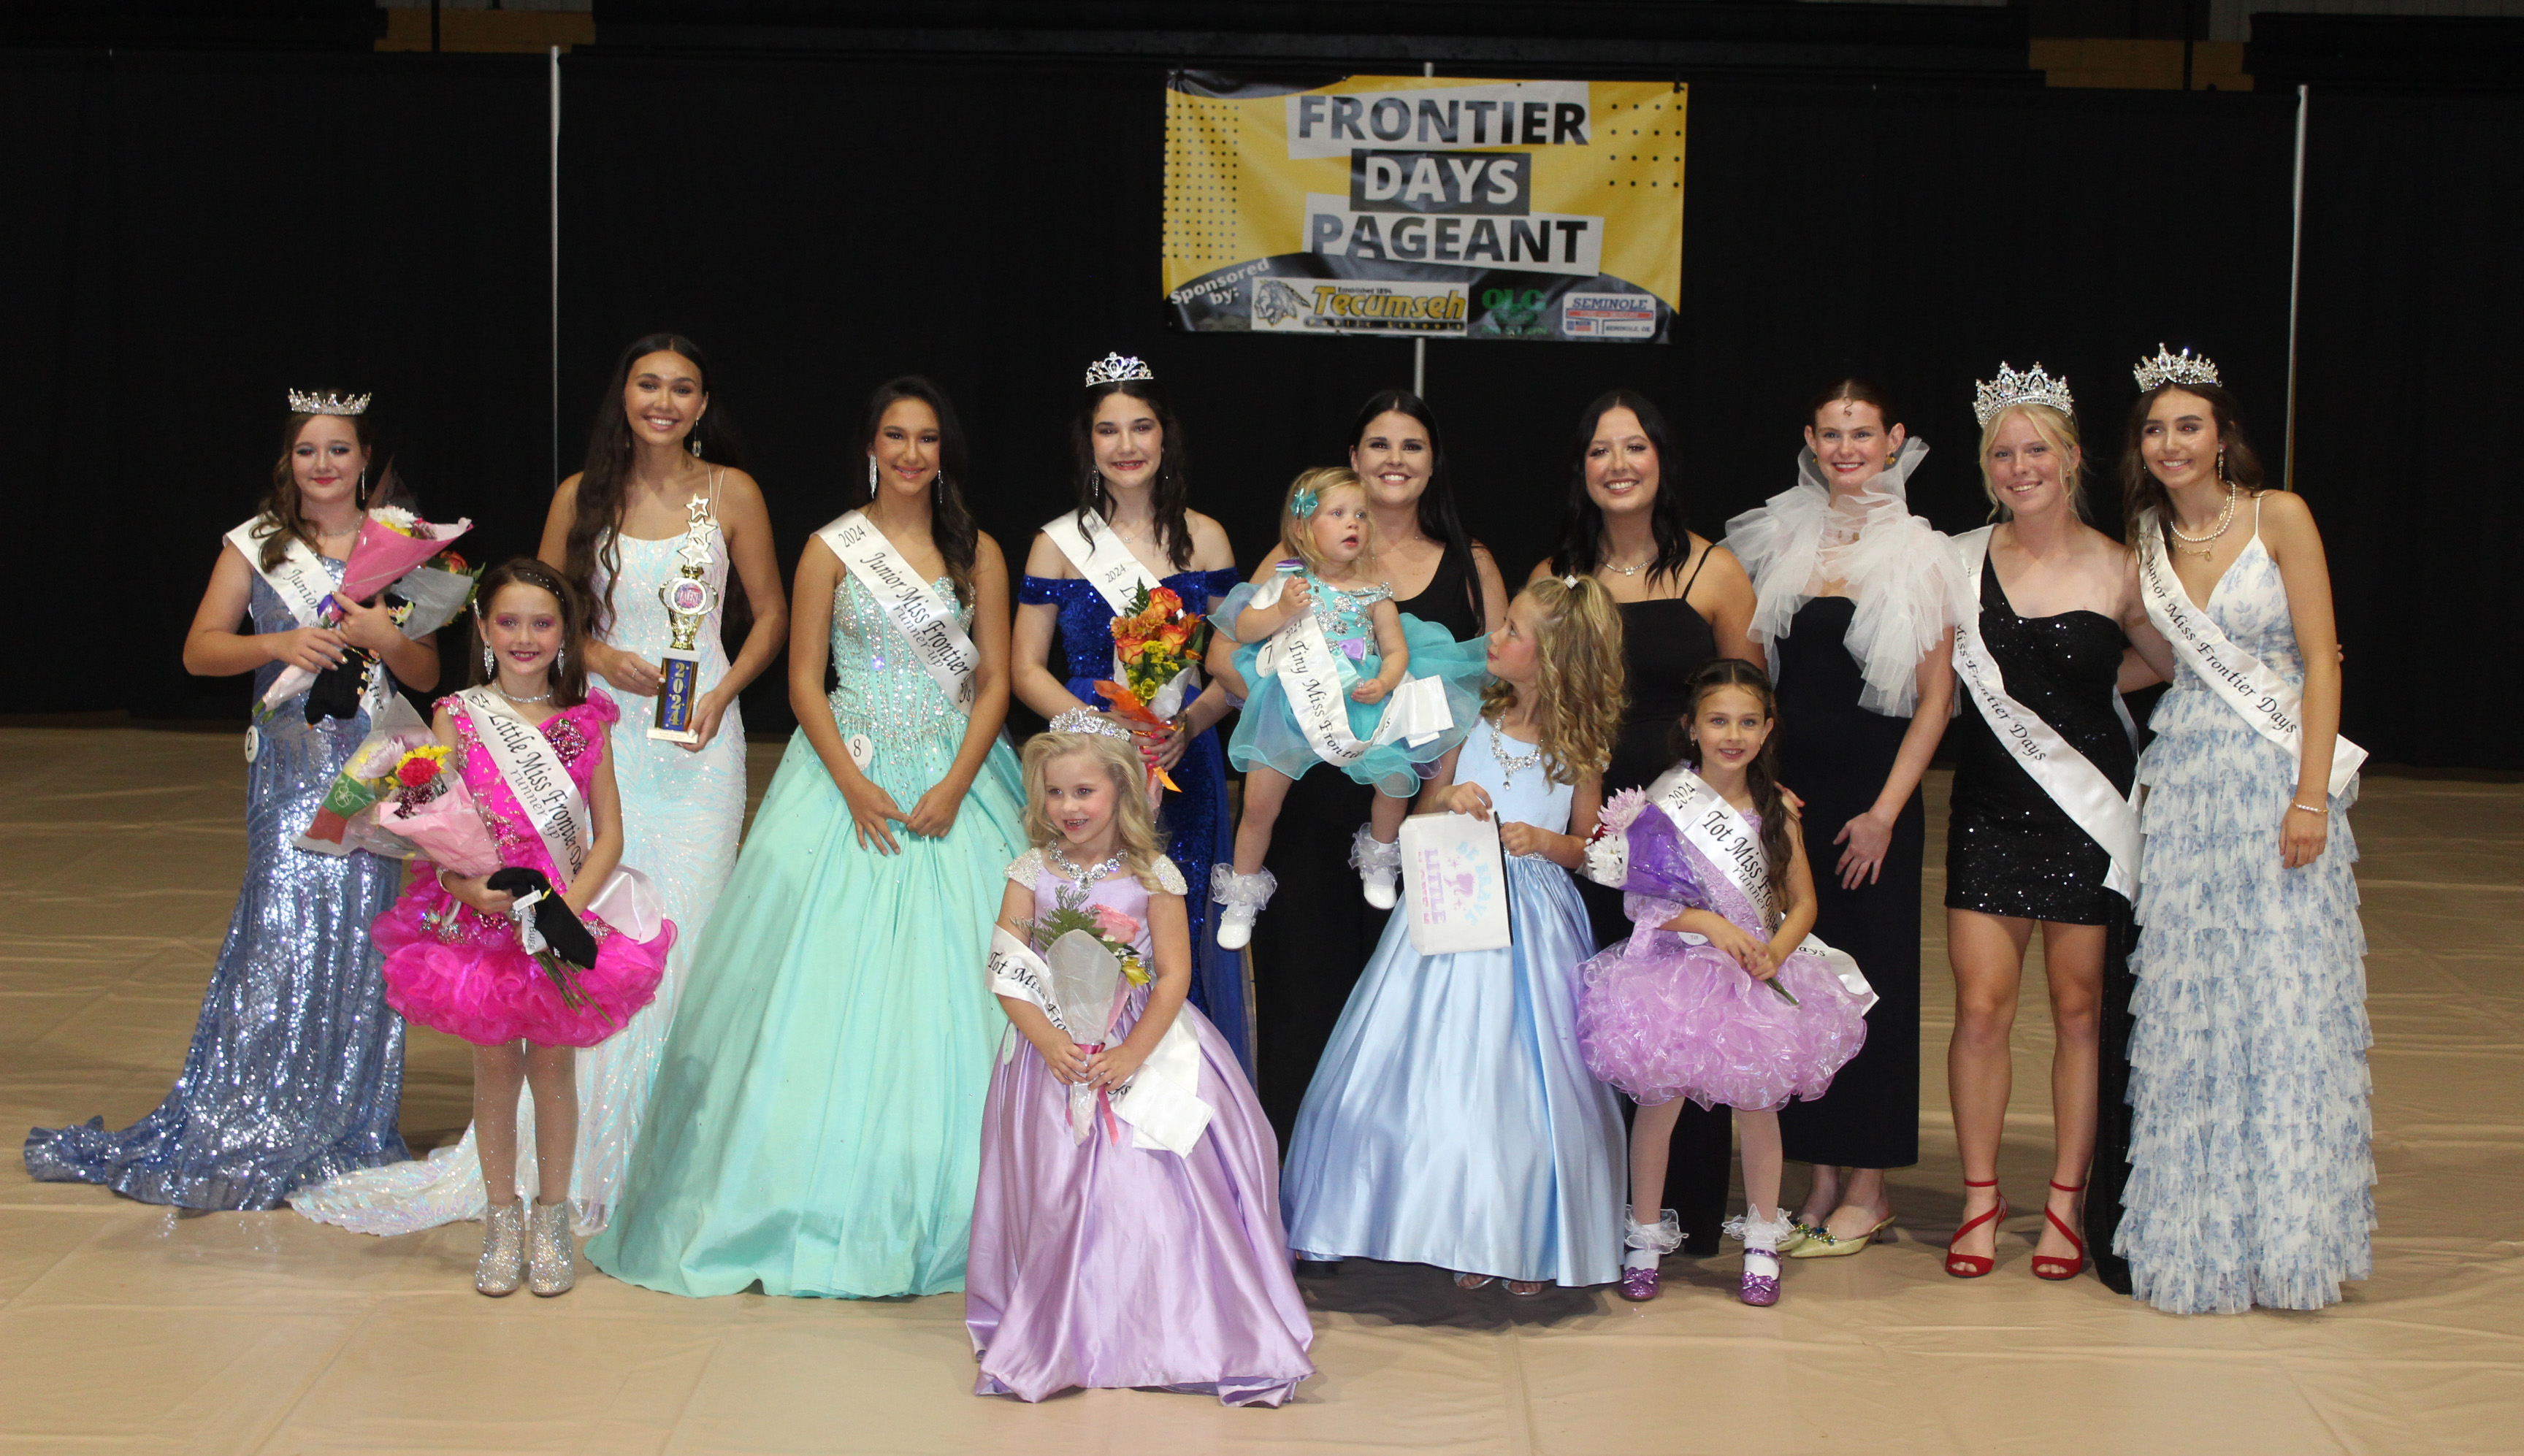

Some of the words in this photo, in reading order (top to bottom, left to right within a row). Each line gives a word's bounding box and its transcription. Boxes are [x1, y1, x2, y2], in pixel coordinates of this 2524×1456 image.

[1299, 96, 1589, 145] FRONTIER
[1364, 156, 1519, 204] DAYS
[1312, 215, 1588, 264] PAGEANT
[1170, 258, 1271, 304] Sponsored
[1209, 286, 1240, 306] by:
[1312, 286, 1466, 319] Tecumseh
[1572, 298, 1648, 310] SEMINOLE
[838, 524, 866, 548] 2024
[283, 569, 319, 609] Junior
[1104, 564, 1127, 583] 2024
[678, 590, 700, 603] TALENT
[860, 552, 907, 590] Junior
[895, 587, 930, 624] Miss
[922, 620, 970, 676] Frontier
[892, 605, 944, 667] runner-up
[1264, 644, 1273, 664] 7
[2146, 555, 2167, 599] Junior
[2164, 602, 2197, 642] Miss
[2197, 640, 2257, 698] Frontier
[2256, 697, 2298, 735] Days
[670, 662, 685, 726] 2024
[1289, 640, 1309, 673] Tiny
[1302, 678, 1327, 717] Miss
[854, 738, 861, 757] 8
[2009, 724, 2046, 761] Days
[489, 716, 535, 754] Little
[516, 751, 552, 792] Miss
[542, 789, 580, 850] Frontier
[570, 846, 582, 883] Da
[510, 768, 561, 839] runner-up
[1668, 781, 1699, 810] 2024
[1702, 811, 1734, 842] Tot
[1725, 836, 1762, 879] Miss
[1424, 848, 1448, 925] LITTLE
[987, 951, 1008, 975] Tot
[1799, 946, 1826, 957] ays
